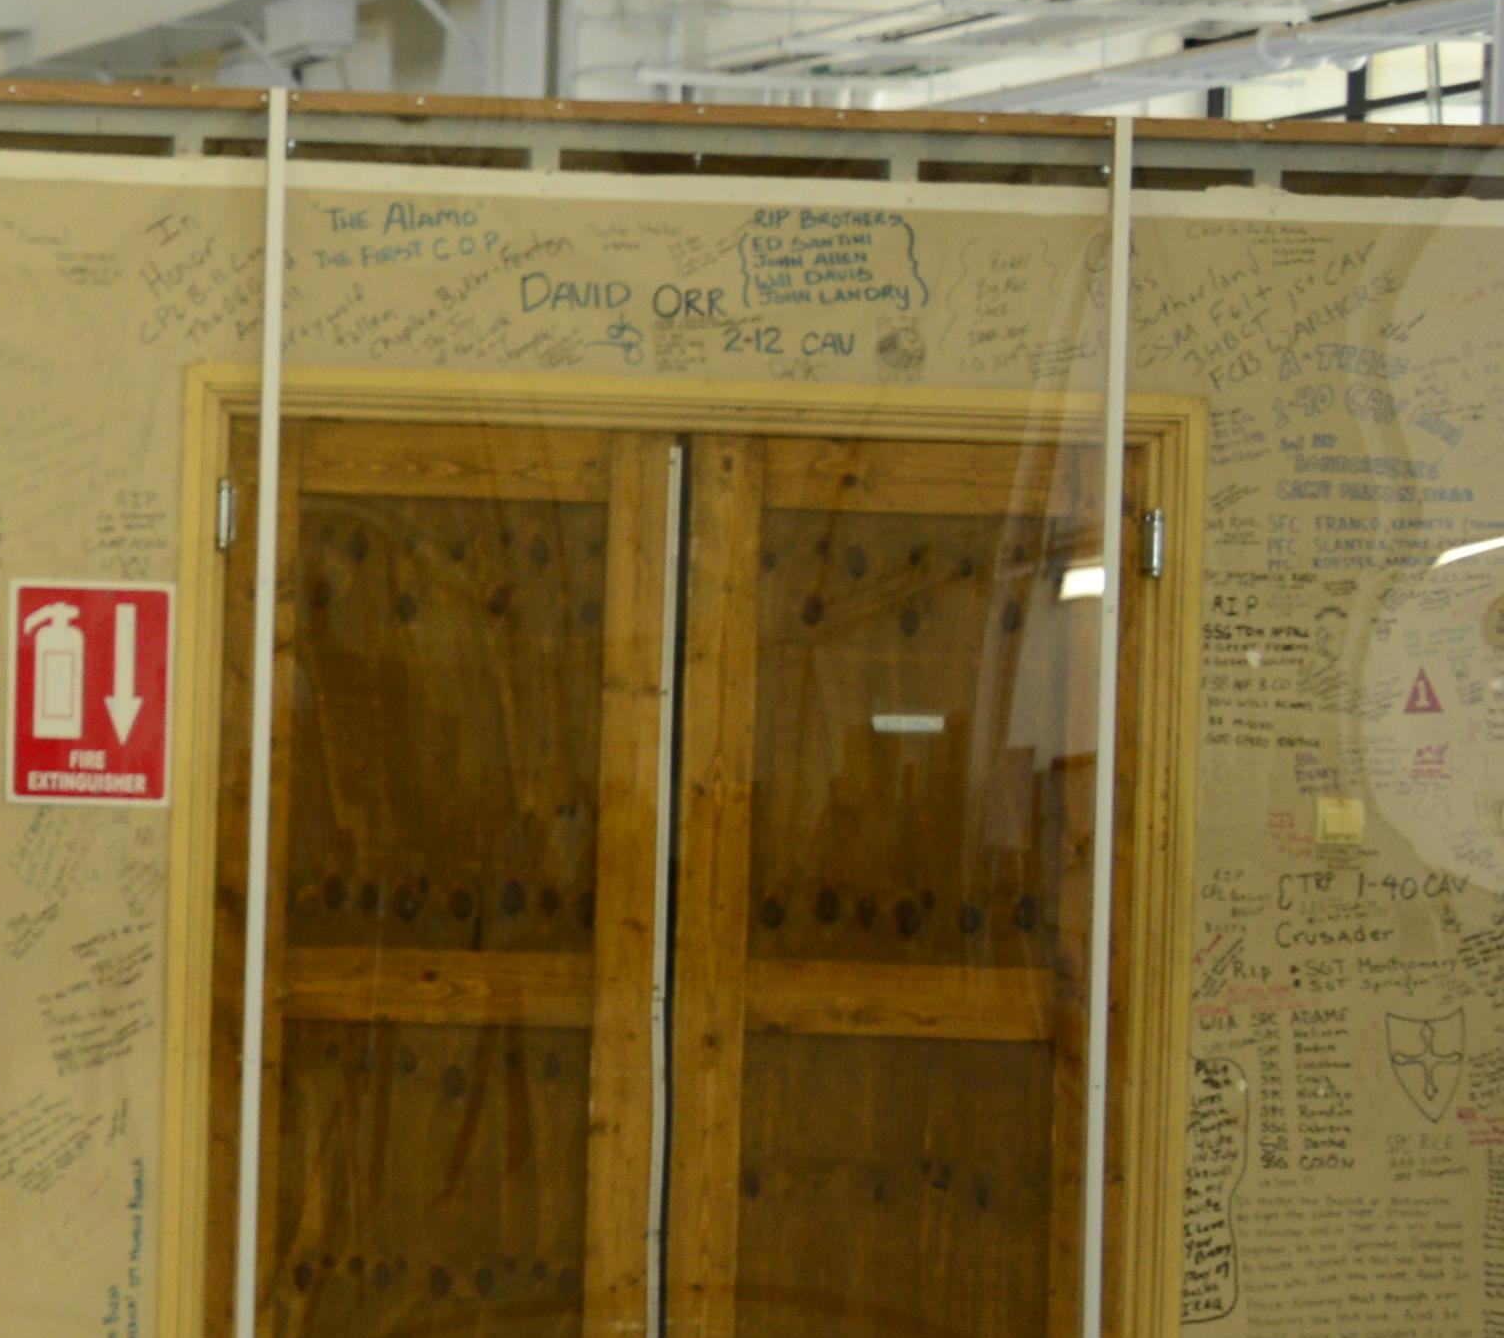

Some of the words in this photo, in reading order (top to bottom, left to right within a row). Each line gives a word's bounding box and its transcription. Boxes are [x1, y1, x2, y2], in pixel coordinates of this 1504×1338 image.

[754, 210, 790, 229] RIP
[521, 272, 631, 313] DAVID
[652, 283, 727, 319] ORR
[724, 327, 784, 356] 2-12
[801, 331, 855, 356] CAV
[69, 750, 107, 770] FIRE
[27, 770, 147, 793] EXTINGUISHER
[1357, 872, 1417, 901] 1-40
[1424, 874, 1469, 898] CAV
[1276, 922, 1394, 949] Crusader
